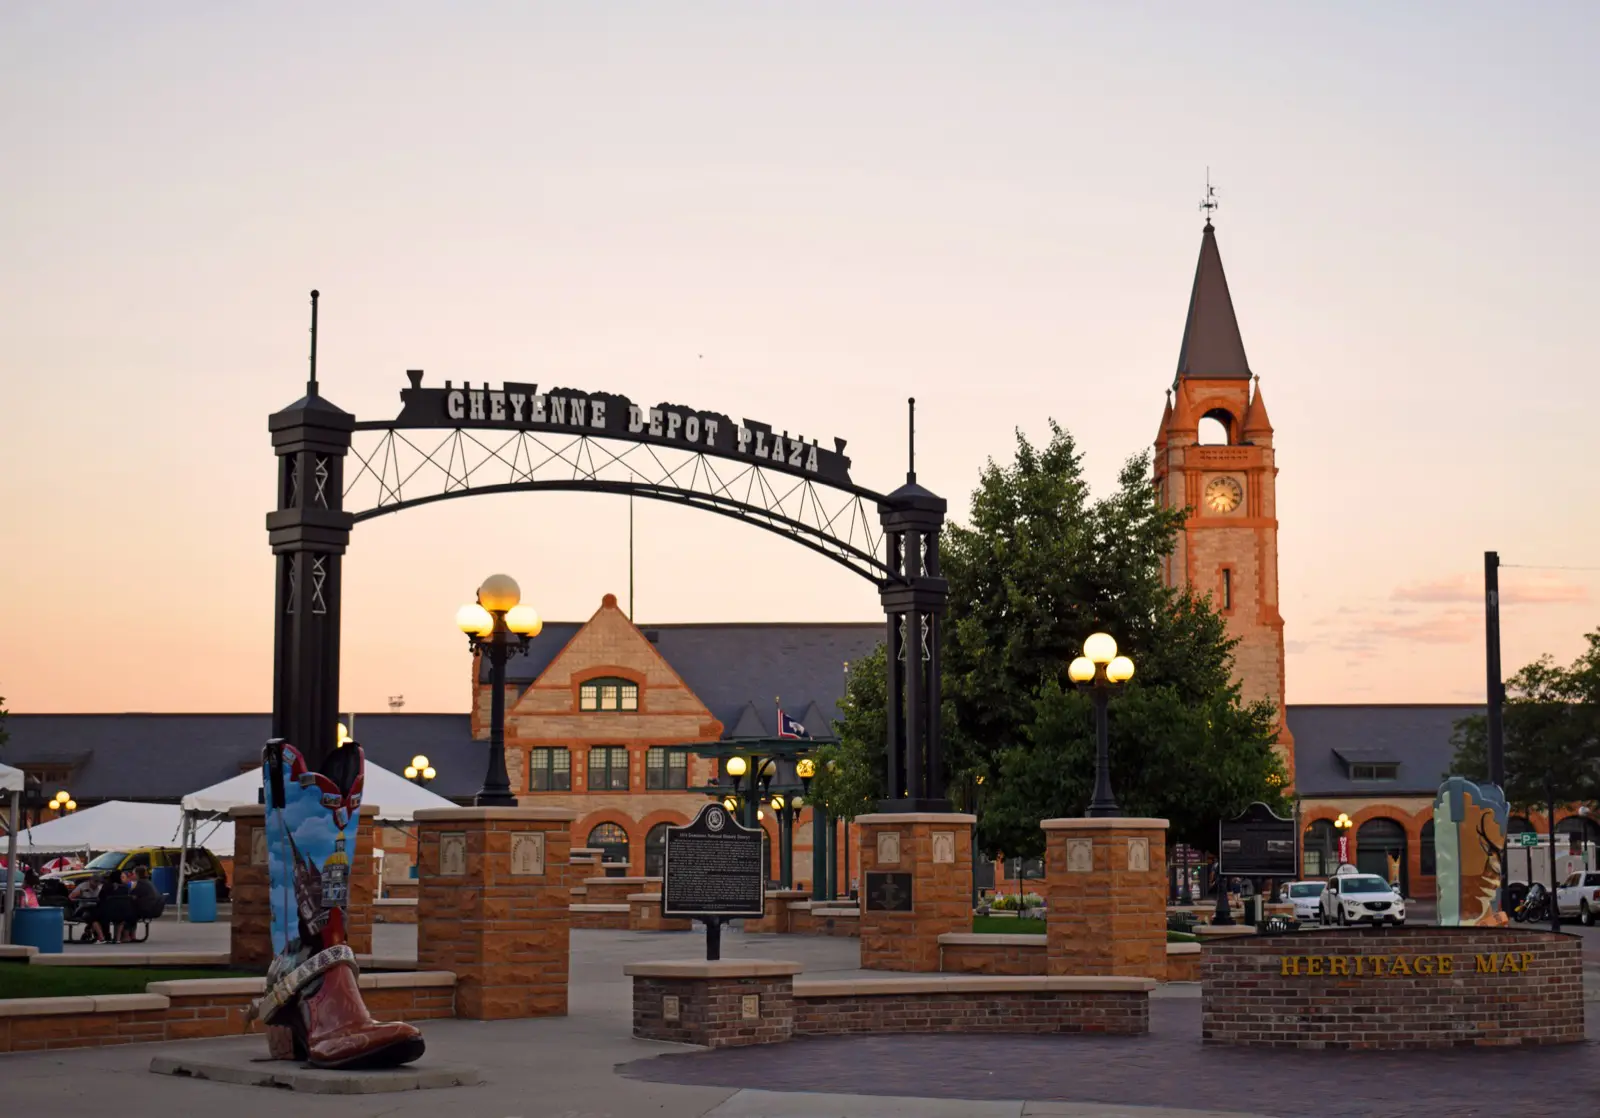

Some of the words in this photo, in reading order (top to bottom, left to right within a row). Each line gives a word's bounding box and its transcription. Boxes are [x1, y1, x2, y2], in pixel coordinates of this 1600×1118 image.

[447, 390, 606, 429] CHEYENNE
[628, 404, 719, 447] DEPOT
[737, 426, 819, 473] PLAZA
[1522, 834, 1531, 845] P
[1279, 954, 1454, 977] HERITAGE
[1475, 951, 1535, 974] MAP
